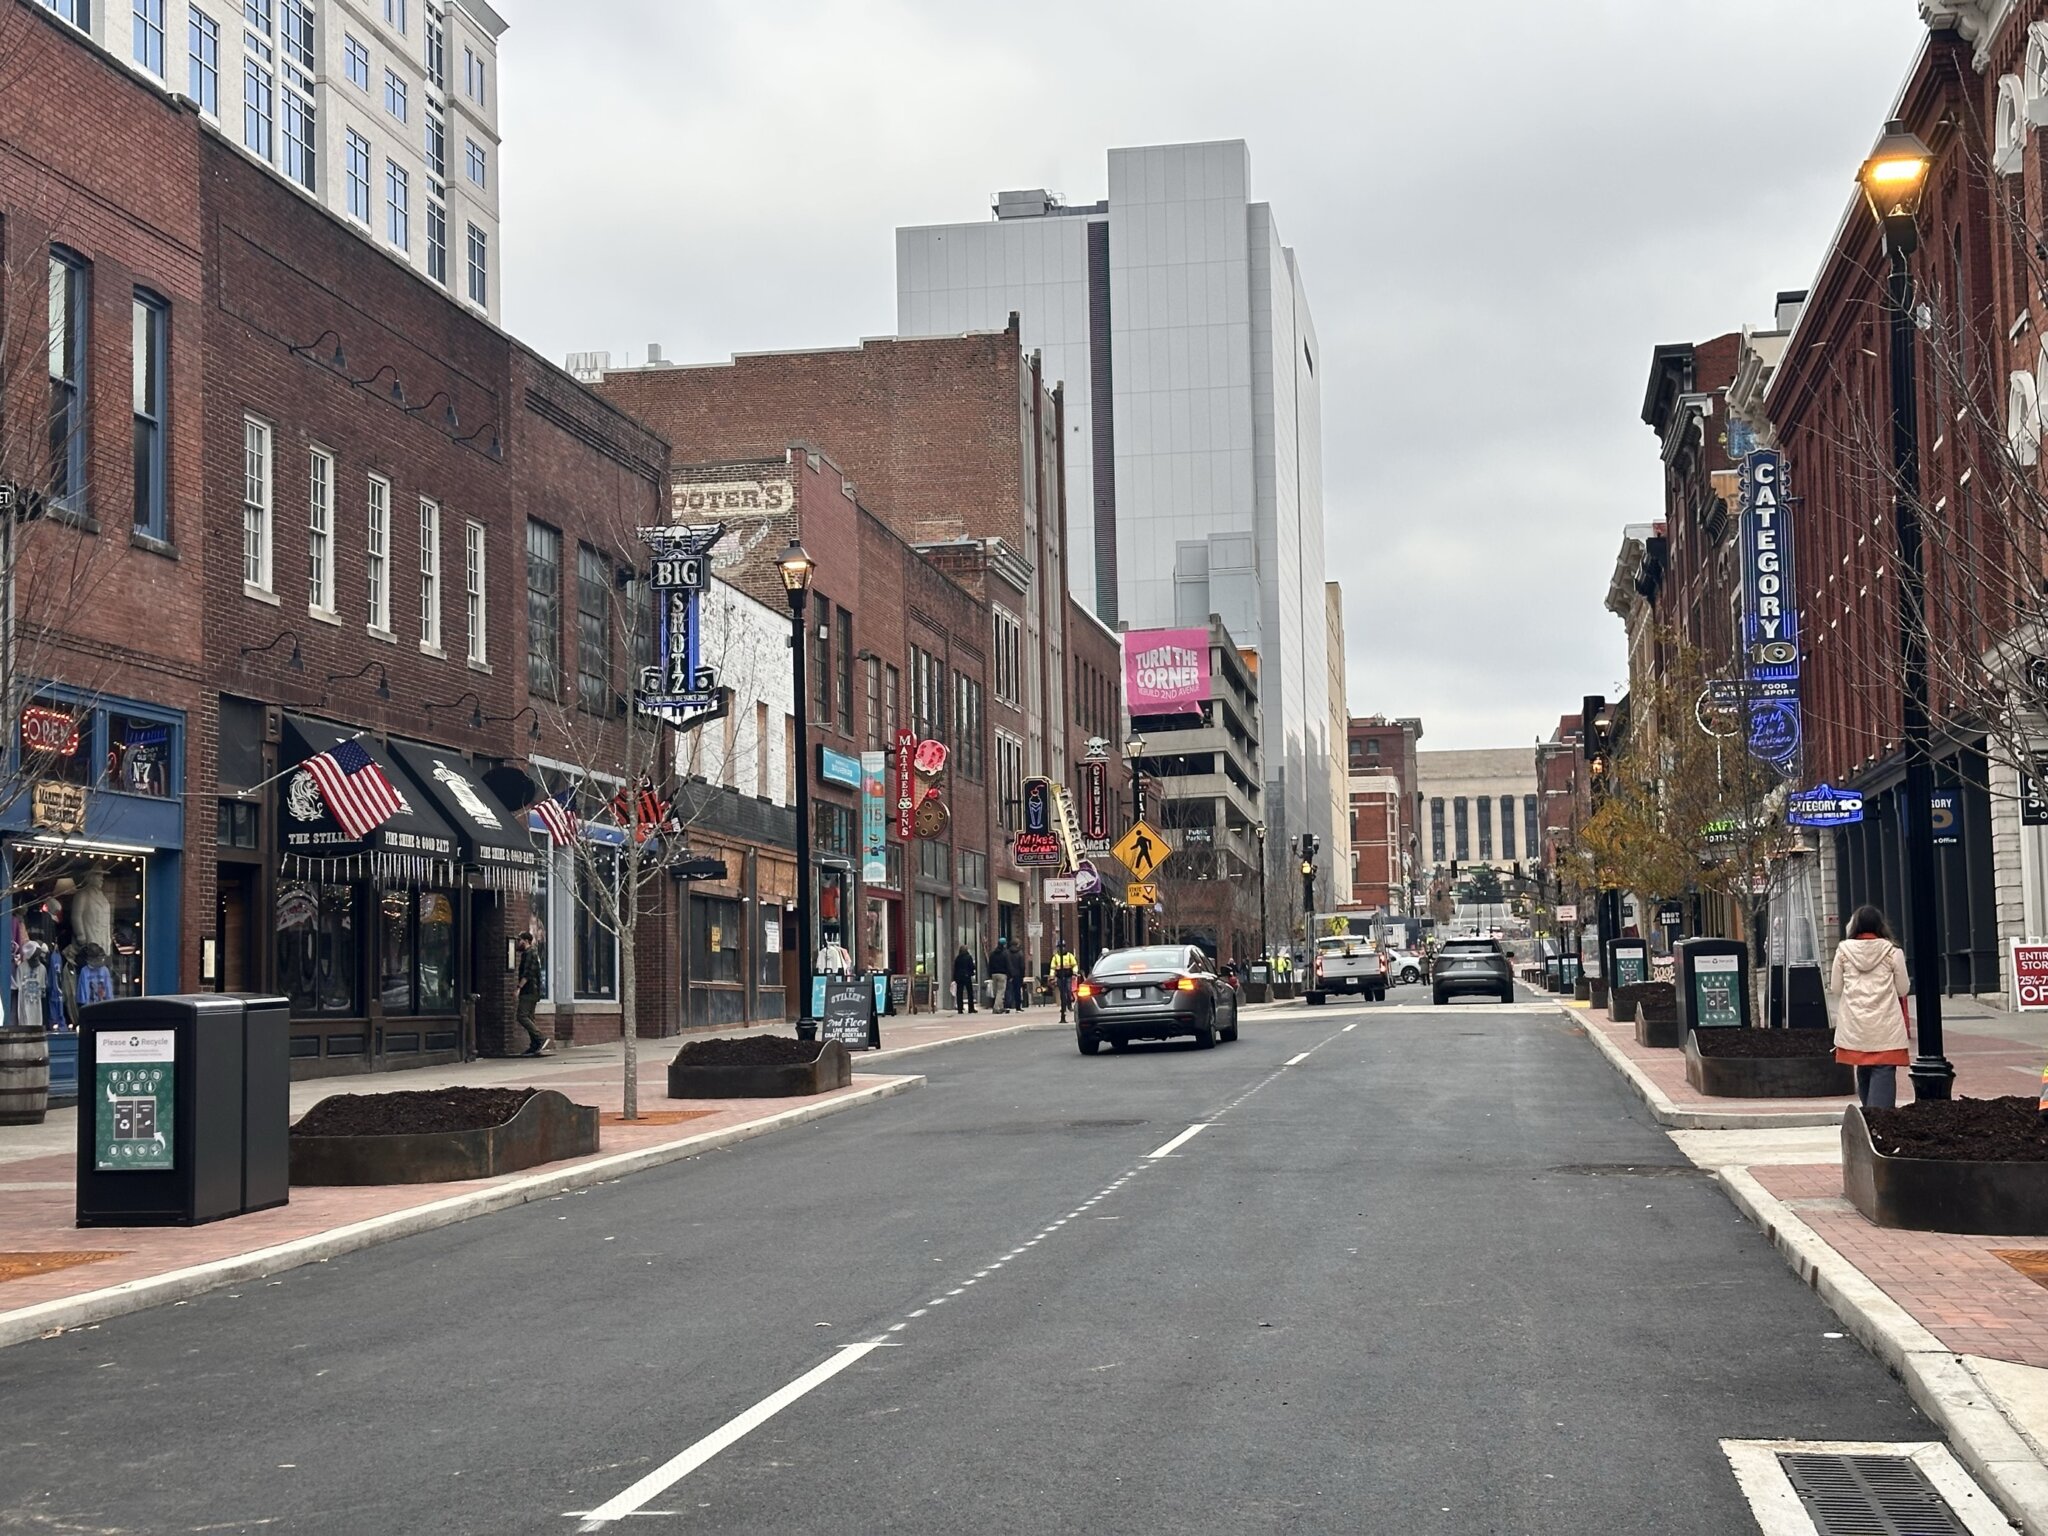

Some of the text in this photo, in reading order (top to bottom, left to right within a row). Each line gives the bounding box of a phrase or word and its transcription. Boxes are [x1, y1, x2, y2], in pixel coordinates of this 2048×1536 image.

[1754, 462, 1785, 639] CATEGORY
[656, 560, 698, 586] BIG
[670, 592, 685, 694] SHOTZ
[1748, 642, 1797, 664] 10
[1136, 645, 1198, 669] TURN THE
[1136, 667, 1199, 689] CORNER
[1160, 689, 1178, 700] 2ND
[1763, 688, 1796, 696] SPORT
[28, 718, 71, 743] OPEN
[1093, 766, 1101, 835] CERVEZA
[1789, 799, 1863, 812] CATEGORY 10
[288, 833, 310, 845] THE
[1020, 834, 1055, 845] Mike's
[103, 1038, 169, 1048] Please Recycle
